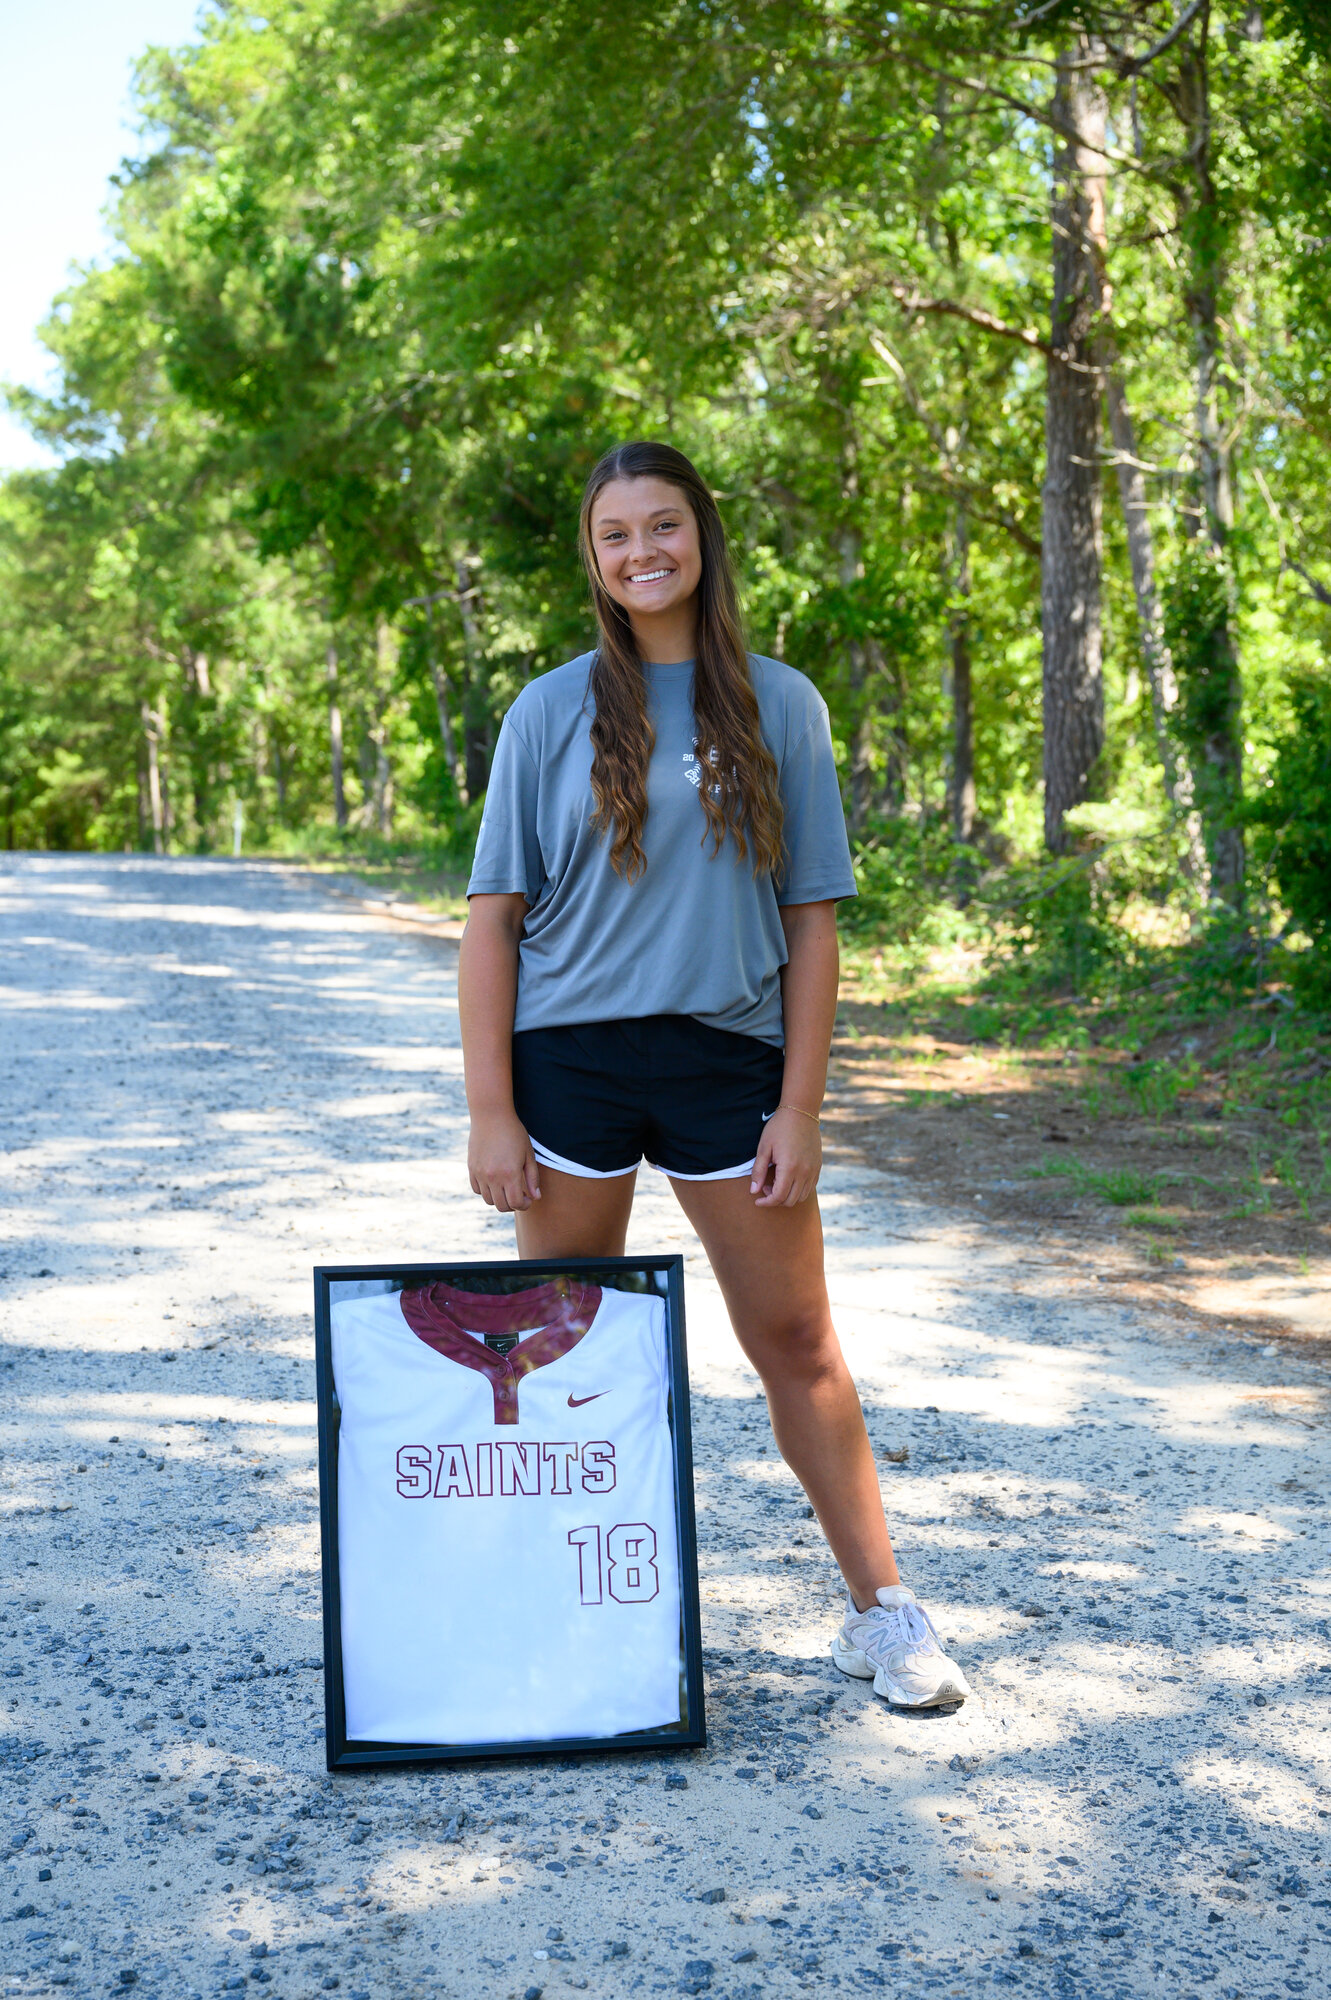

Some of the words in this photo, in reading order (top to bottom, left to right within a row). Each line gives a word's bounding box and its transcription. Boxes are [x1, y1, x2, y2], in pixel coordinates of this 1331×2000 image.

[682, 753, 695, 762] 20
[396, 1440, 617, 1499] SAINTS
[568, 1521, 660, 1606] 18
[867, 1627, 898, 1655] N
